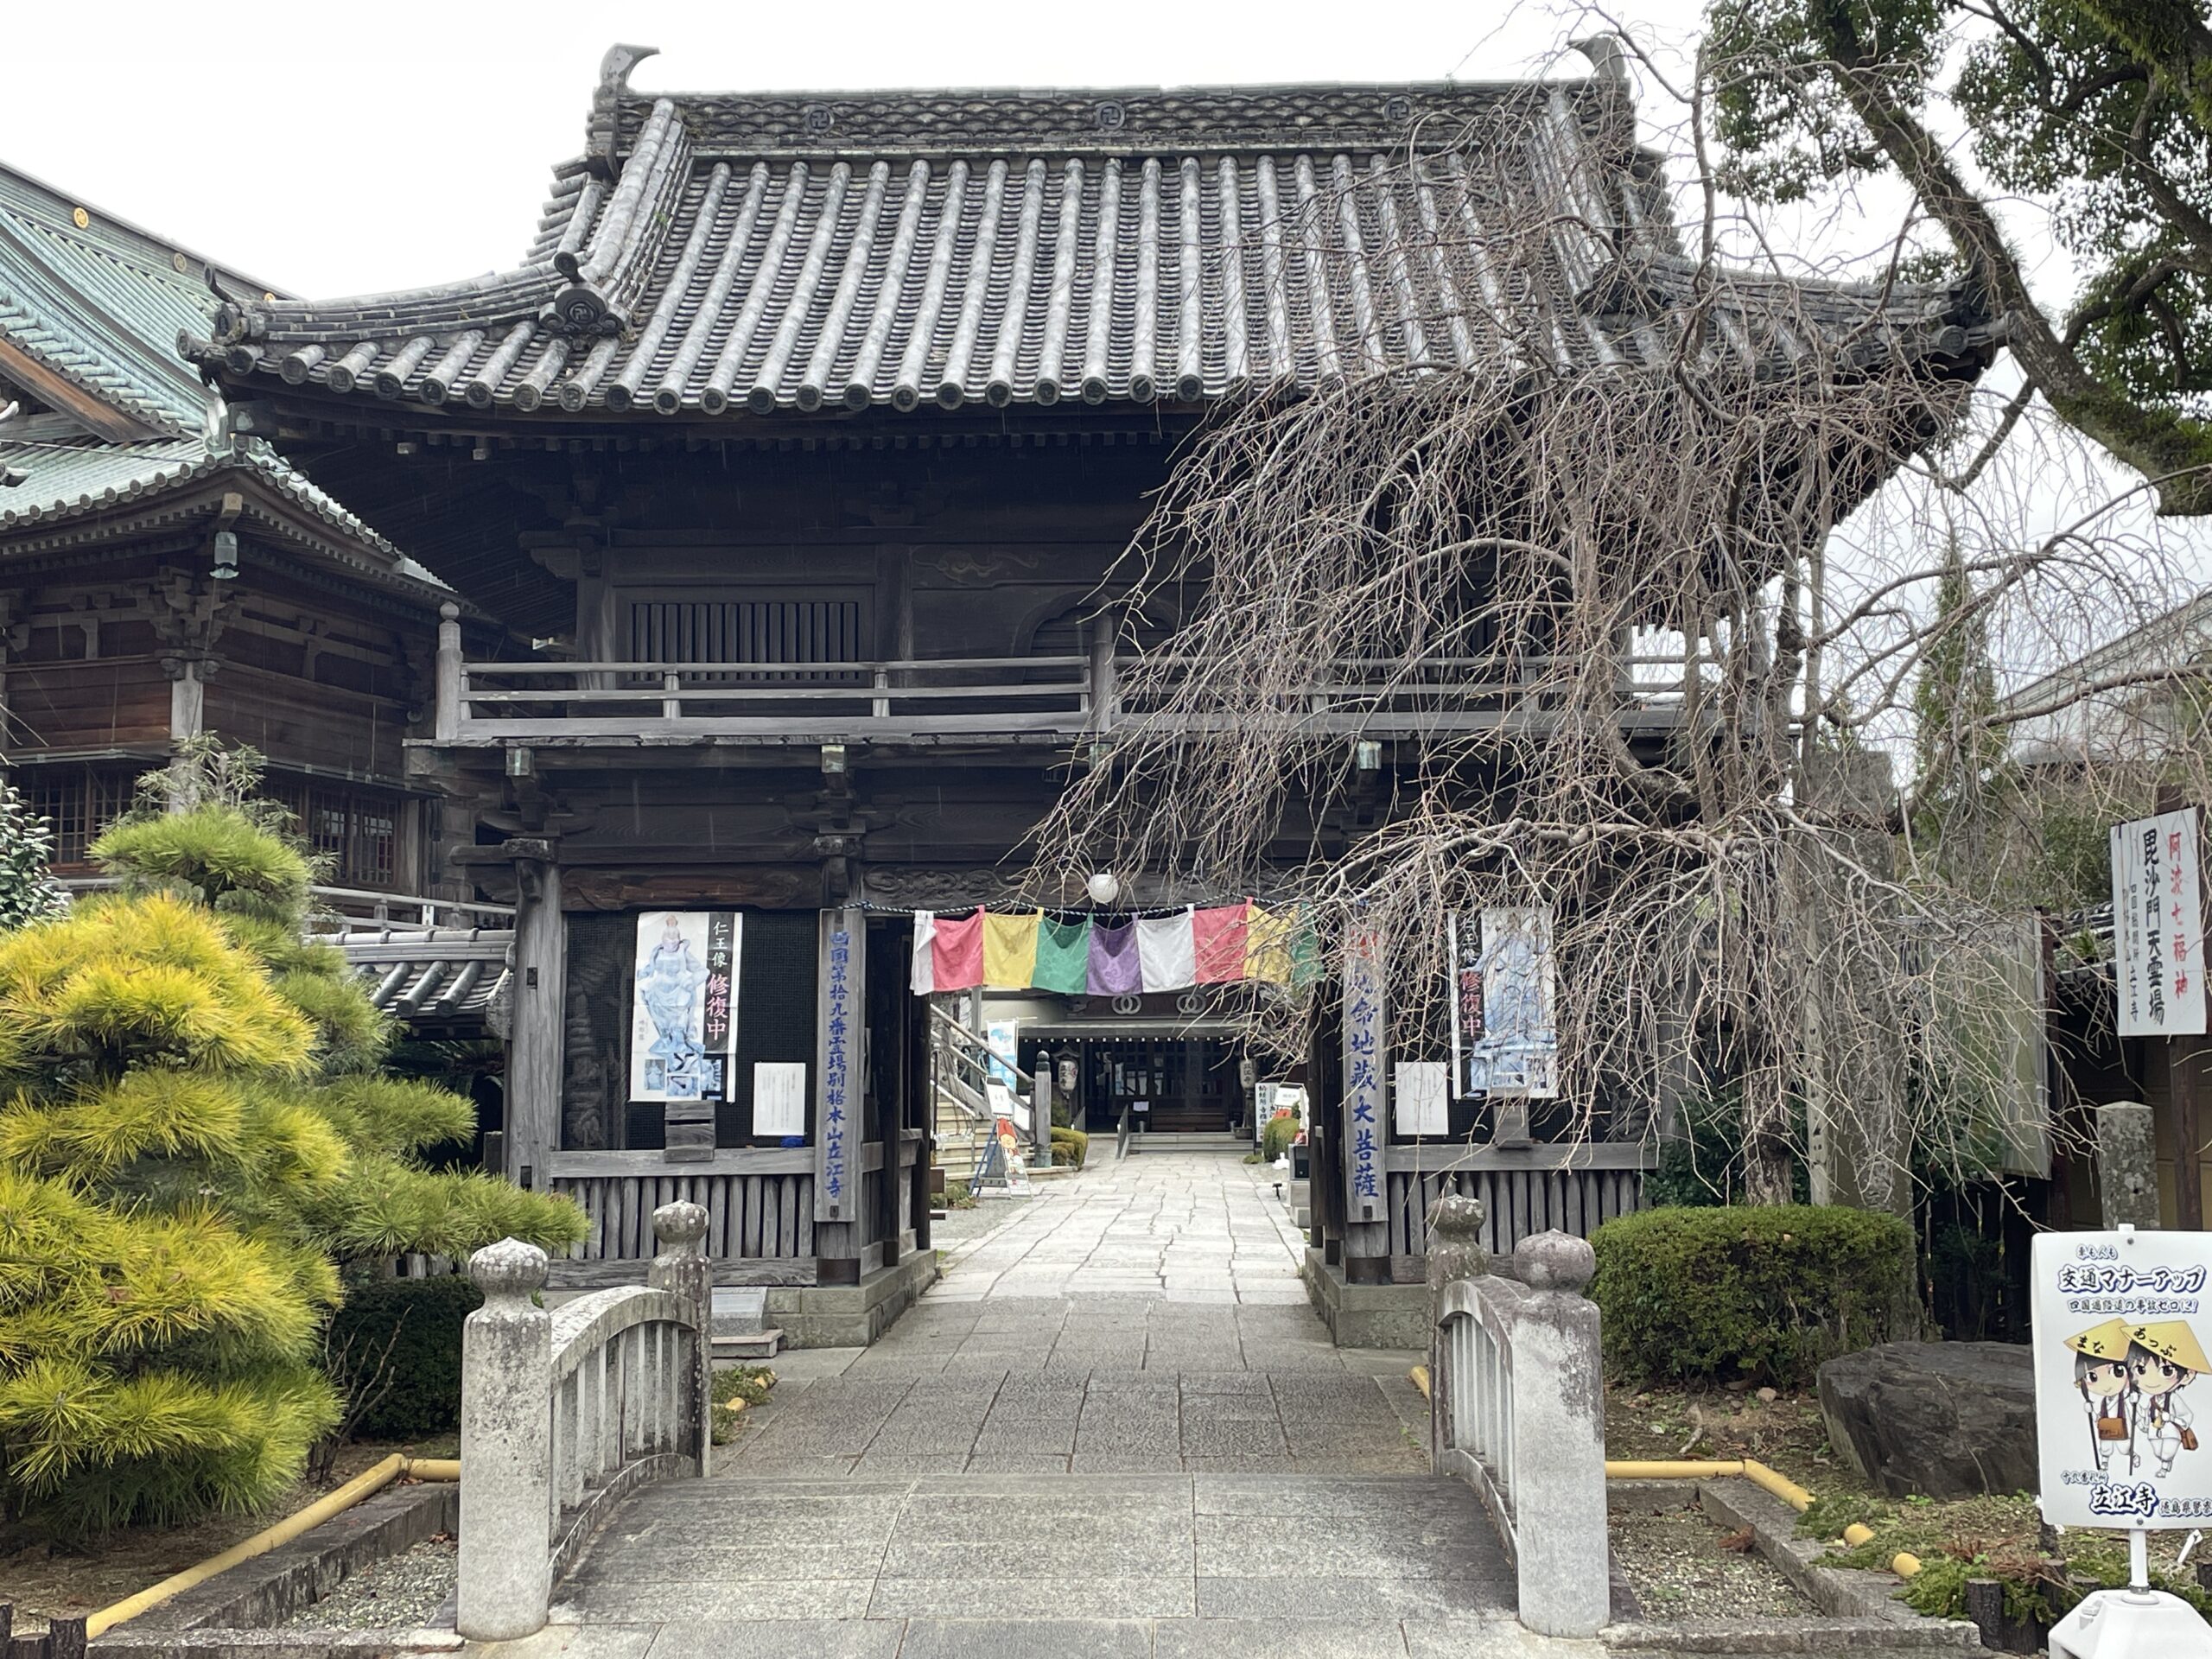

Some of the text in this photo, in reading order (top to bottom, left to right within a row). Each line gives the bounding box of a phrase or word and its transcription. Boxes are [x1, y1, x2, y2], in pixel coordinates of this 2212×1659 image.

[2143, 829, 2166, 1026] 毘沙門天霊場
[2168, 832, 2188, 1000] 阿波七福神
[707, 921, 730, 1040] 仁王像 修復中
[1460, 970, 1482, 1038] 修復中
[2077, 1245, 2118, 1260] 車も人も
[2060, 1266, 2204, 1291] 交通マナーアップ
[2077, 1334, 2105, 1354] まな
[2092, 1484, 2157, 1515] 立江寺
